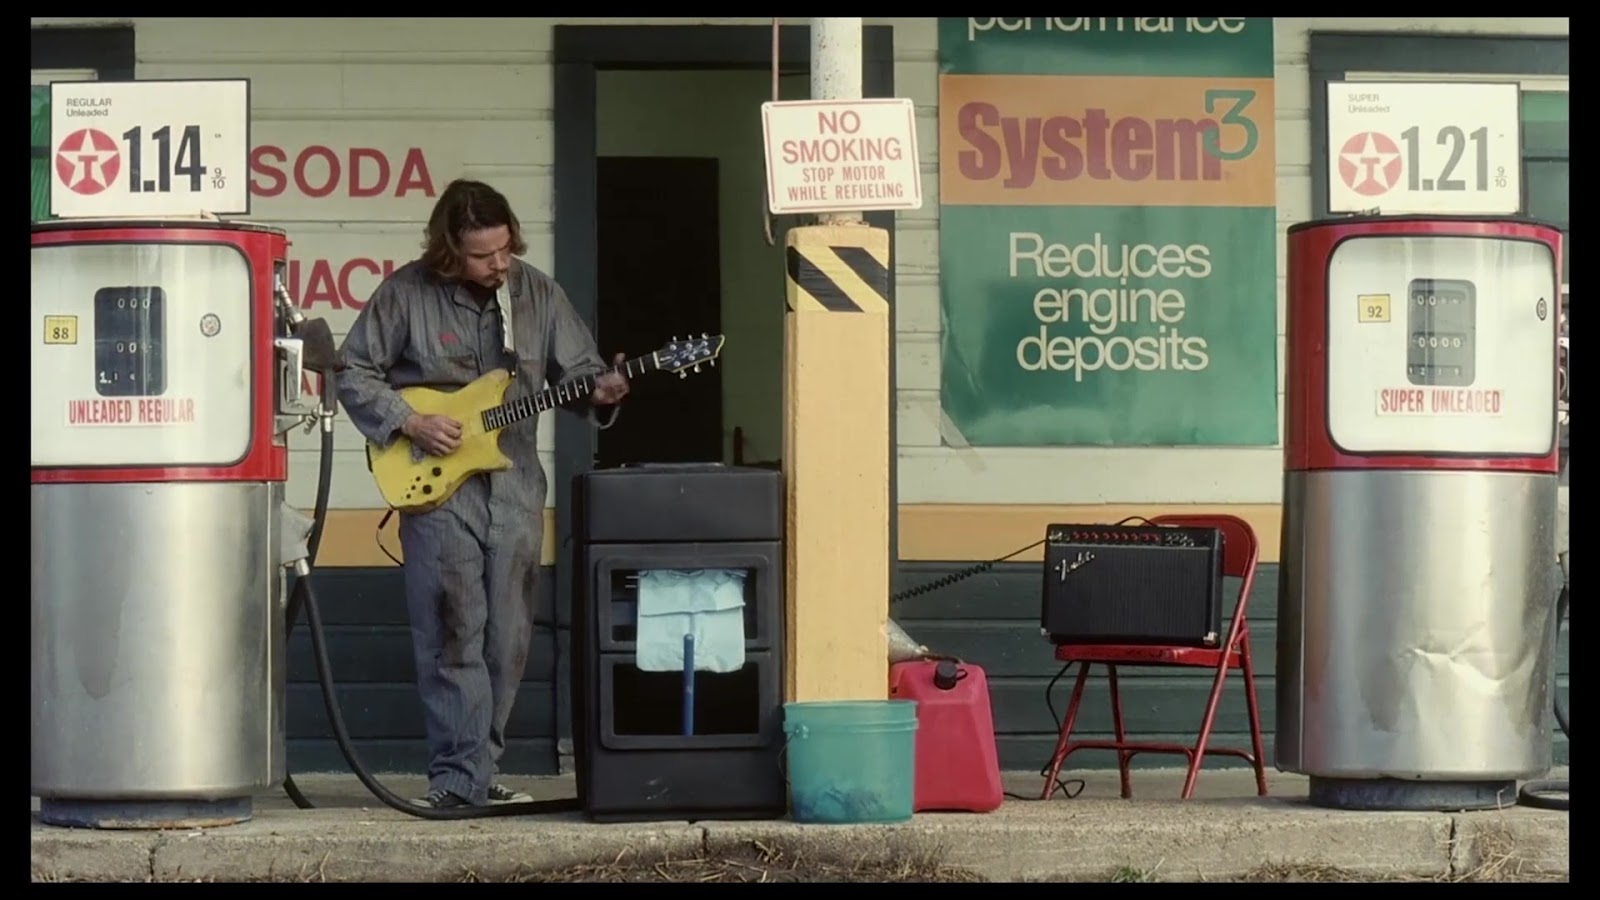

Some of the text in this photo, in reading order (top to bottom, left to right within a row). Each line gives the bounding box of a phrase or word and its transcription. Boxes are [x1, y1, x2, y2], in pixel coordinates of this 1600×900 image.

[66, 98, 112, 107] REGULAR
[1348, 94, 1380, 102] SUPER
[1348, 105, 1391, 113] Unleaded
[66, 108, 109, 117] Unleaded
[818, 110, 861, 134] NO
[782, 137, 902, 164] SMOKING
[957, 89, 1259, 189] System 3
[122, 125, 207, 193] 1.14
[1400, 125, 1488, 191] 1.21
[250, 145, 436, 198] SODA
[803, 165, 886, 183] STOP MOTOR
[787, 183, 904, 202] WHILE REFUELING
[1009, 232, 1212, 278] Reduces
[288, 258, 393, 311] AC
[1033, 278, 1186, 335] engine
[1367, 305, 1383, 318] 92
[52, 327, 69, 340] 88
[1016, 325, 1209, 382] deposits
[69, 399, 195, 424] UNLEADED REGULAR
[1381, 389, 1500, 413] SUPER UNLEADED
